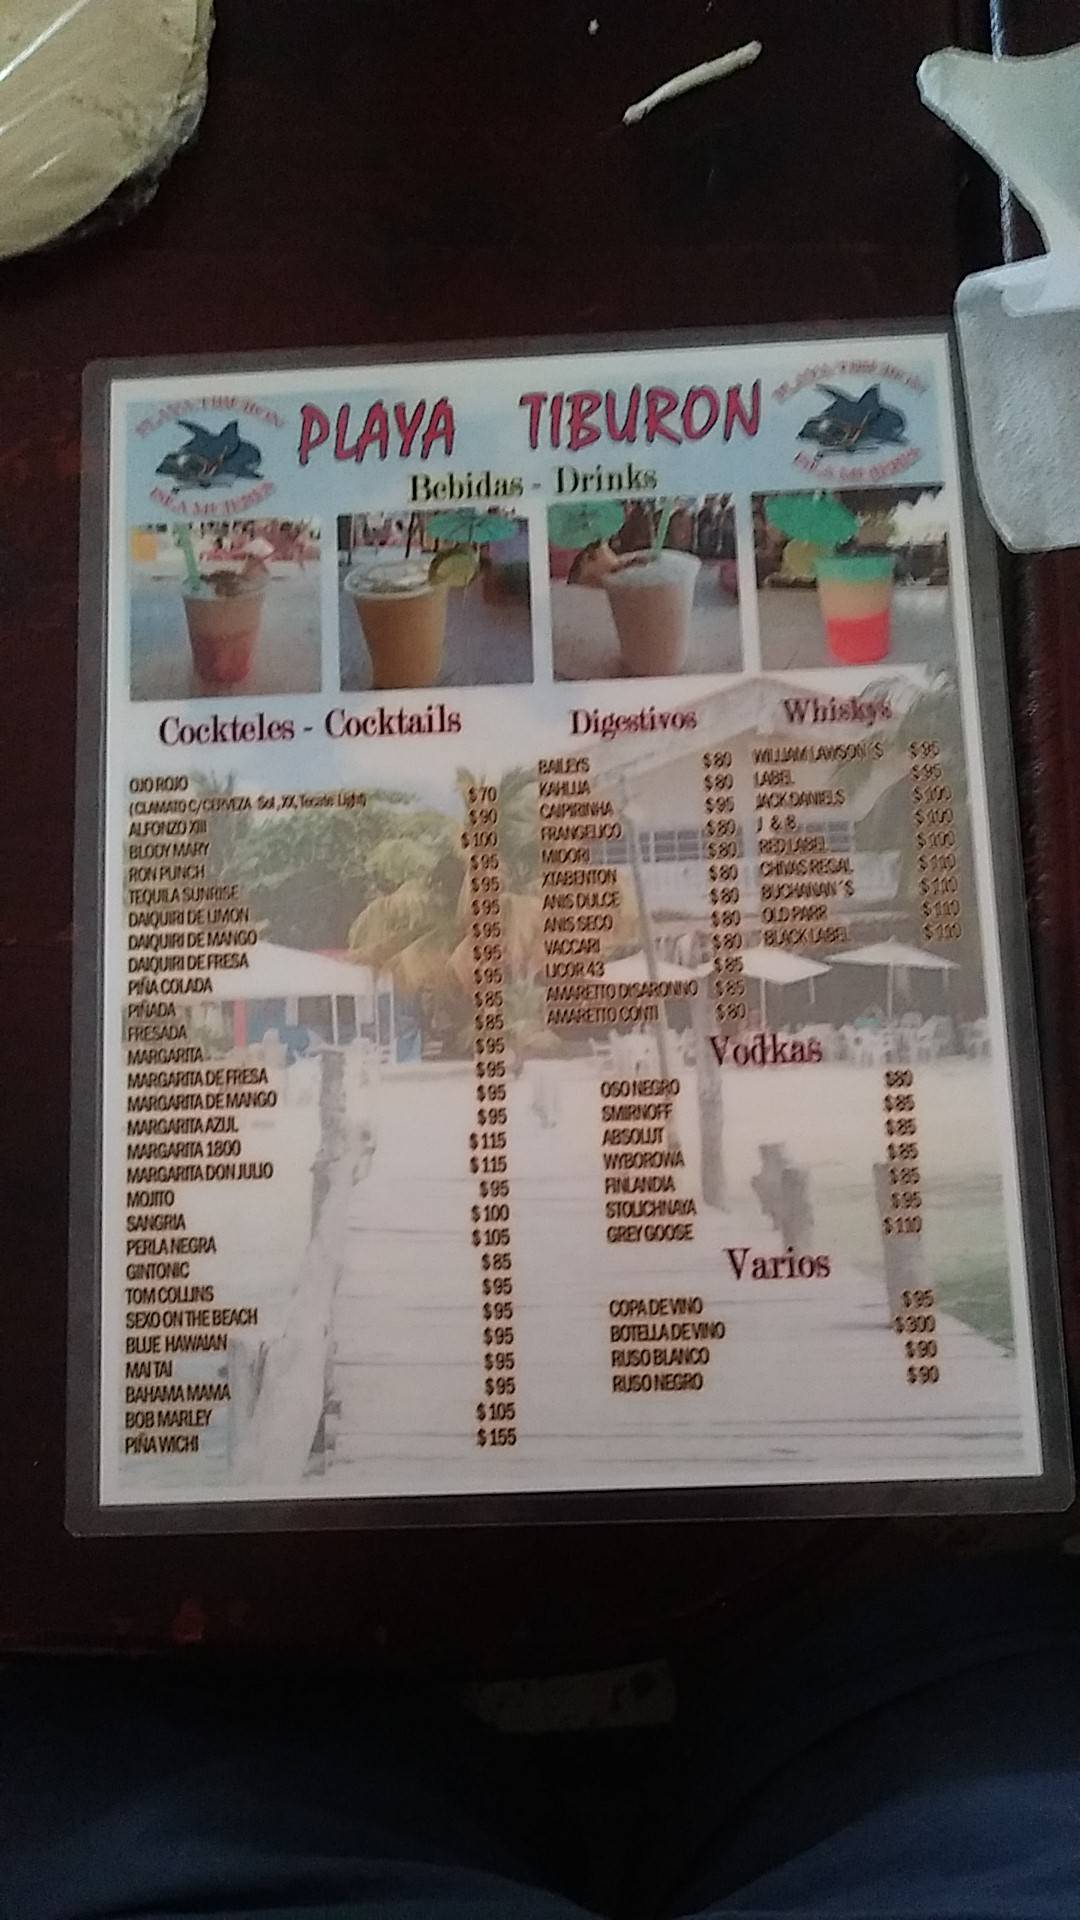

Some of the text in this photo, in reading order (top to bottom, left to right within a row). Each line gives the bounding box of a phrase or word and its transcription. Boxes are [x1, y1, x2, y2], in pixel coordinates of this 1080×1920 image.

[298, 378, 762, 467] PLAYA TIBURON
[409, 471, 524, 501] Bebidas
[556, 463, 658, 495] Drinks
[784, 697, 892, 727] Whiskys
[159, 712, 295, 746] Cockteles
[325, 704, 462, 739] Cocktails
[569, 705, 698, 740] Digestivos
[752, 746, 807, 763] WILLIAM
[538, 757, 590, 775] BAILEYS
[129, 775, 188, 793] OJO ROJO
[755, 769, 796, 787] LABEL
[539, 780, 591, 798] KAHLUA
[756, 788, 846, 809] JACK DANIELS
[539, 800, 614, 819] CAIPIRINHA
[128, 820, 187, 837] ALFONZO
[541, 822, 622, 841] FRANGELICO
[129, 841, 210, 860] BLODY MARY
[542, 848, 590, 864] MIDORI
[128, 864, 205, 883] RON PUNCH
[760, 857, 854, 877] CHIVAS REGAL
[541, 869, 617, 888] XTABENTON
[128, 884, 240, 906] TEQUILA SUNRISE
[542, 891, 621, 911] ANIS DULCE
[128, 907, 249, 929] DAIQUIRI DE LIMON
[543, 914, 613, 933] ANIS SECO
[762, 906, 789, 924] OLD
[128, 929, 258, 951] DAIQUIRI DE MANGO
[544, 938, 601, 955] VACCARI
[764, 928, 808, 946] BLACK
[128, 952, 249, 975] DAIQUIRI DE FRESA
[546, 960, 605, 979] LICOR 43
[128, 976, 213, 996] PIÑA COLADA
[546, 980, 698, 1001] AMARETTO DISARONNO
[547, 1004, 659, 1025] AMARETTO CONTI
[128, 1024, 187, 1042] FRESADA
[127, 1047, 203, 1066] MARGARITA
[710, 1032, 824, 1067] Vodkas
[127, 1067, 268, 1090] MARGARITA DE FRESA
[600, 1078, 680, 1098] OSO NEGRO
[127, 1090, 277, 1113] MARGARITA DE MANGO
[602, 1103, 673, 1122] SMIRNOFF
[127, 1116, 239, 1137] MARGARITA AZUL
[602, 1127, 664, 1146] ABSOLUT
[127, 1139, 241, 1161] MARGARITA 1800
[603, 1150, 685, 1170] WYBOROWA
[127, 1161, 274, 1184] MARGARITA DON JULIO
[605, 1175, 676, 1194] FINLANDIA
[127, 1189, 175, 1209] MOJITO
[605, 1199, 697, 1218] STOLICHNAYA
[126, 1213, 186, 1233] SANGRIA
[607, 1223, 694, 1243] GREY GOOSE
[126, 1235, 217, 1257] PERLA NEGRA
[724, 1246, 831, 1280] Varios
[126, 1285, 214, 1305] TOM COLLINS
[609, 1296, 703, 1318] COPA DE VINO
[126, 1307, 258, 1329] SEXO ON THE BEACH
[611, 1321, 726, 1343] BOTELLA DE VINO
[126, 1335, 160, 1354] BLUE
[611, 1346, 710, 1368] RUSO BLANCO
[126, 1360, 172, 1379] MAI TAI
[612, 1372, 704, 1393] RUSO NEGRO
[126, 1383, 231, 1404] BAHAMA MAMA
[125, 1409, 212, 1429] BOB MARLEY
[125, 1432, 199, 1454] PIÑA WICHI
